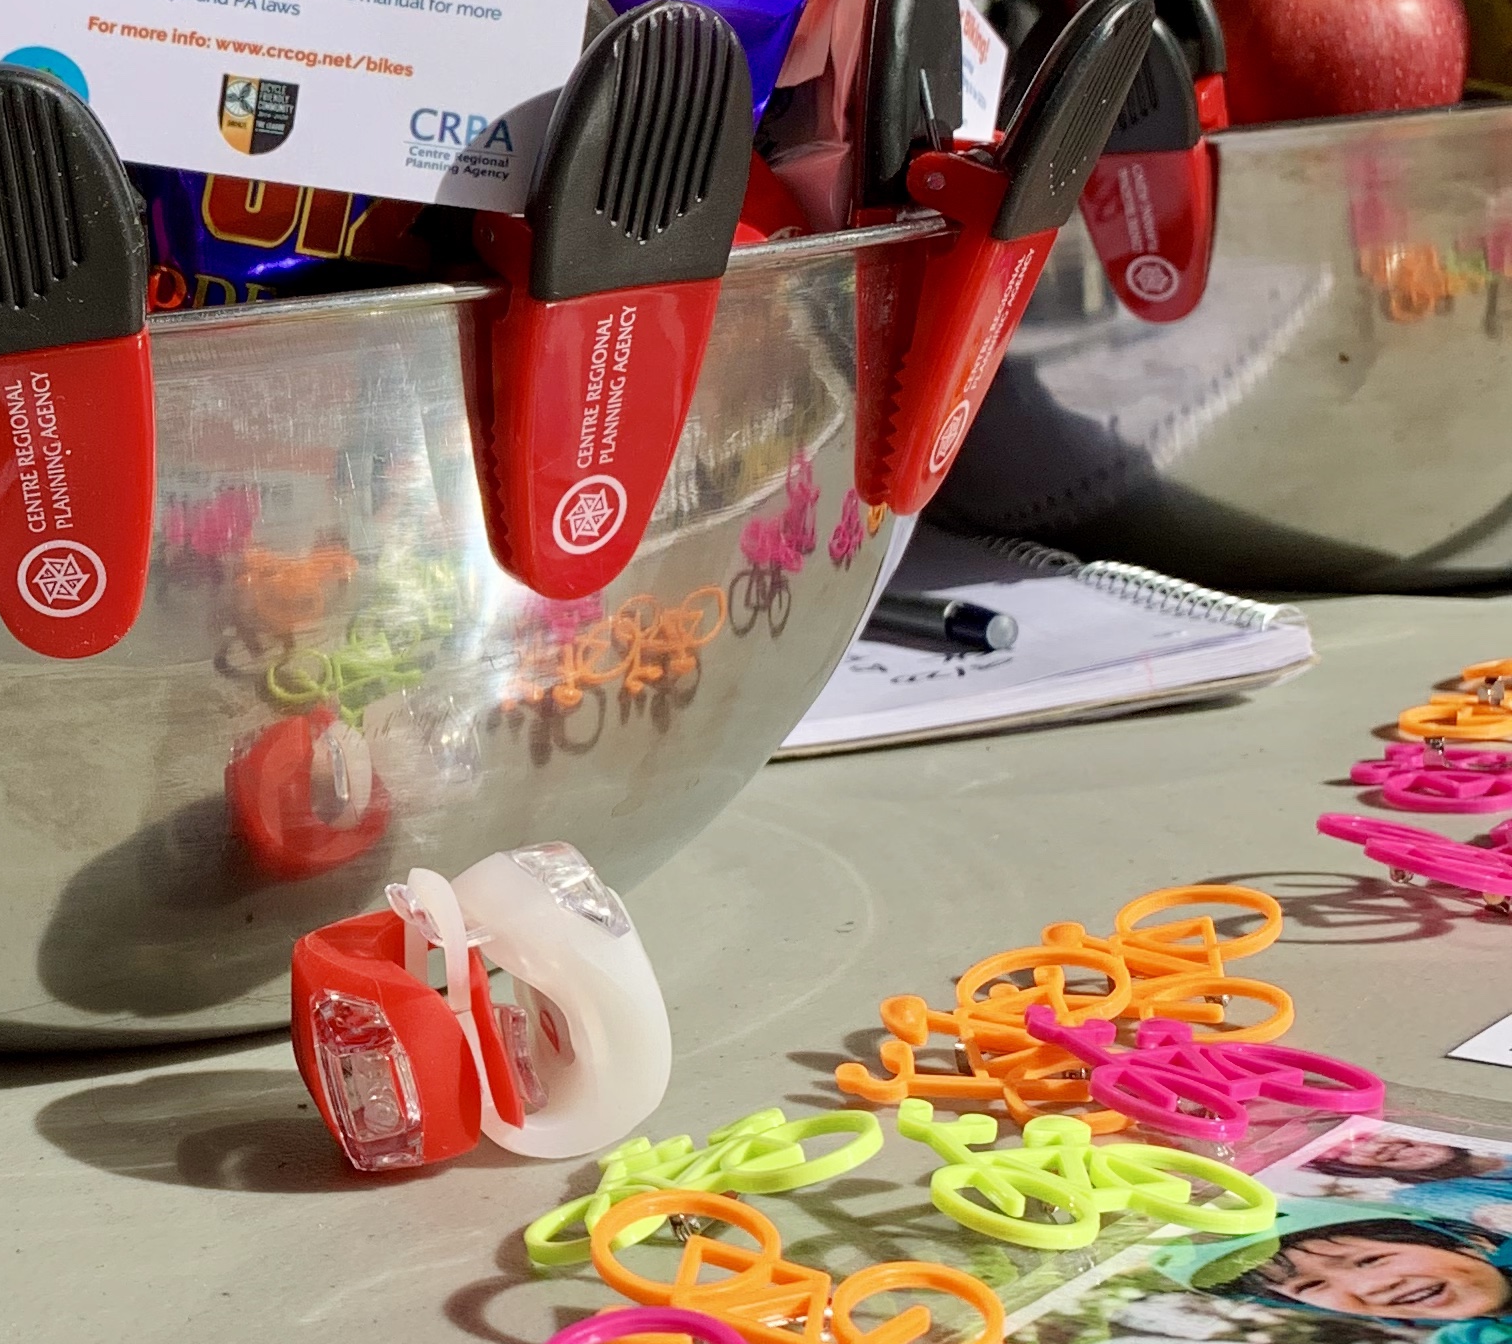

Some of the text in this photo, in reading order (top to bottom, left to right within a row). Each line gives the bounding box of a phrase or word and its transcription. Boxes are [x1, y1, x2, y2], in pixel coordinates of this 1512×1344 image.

[455, 2, 503, 21] more
[86, 14, 414, 78] For more info: www.crcog.net/bikes
[409, 107, 514, 153] CRPA
[409, 145, 451, 162] Centre
[405, 157, 509, 182] Planning Agency
[577, 314, 613, 468] CENTRE REGIONAL
[599, 305, 637, 464] PLANNING AGENCY
[5, 380, 46, 533] CENTRE REGIONAL
[30, 371, 73, 529] PLANNING AGENCY
